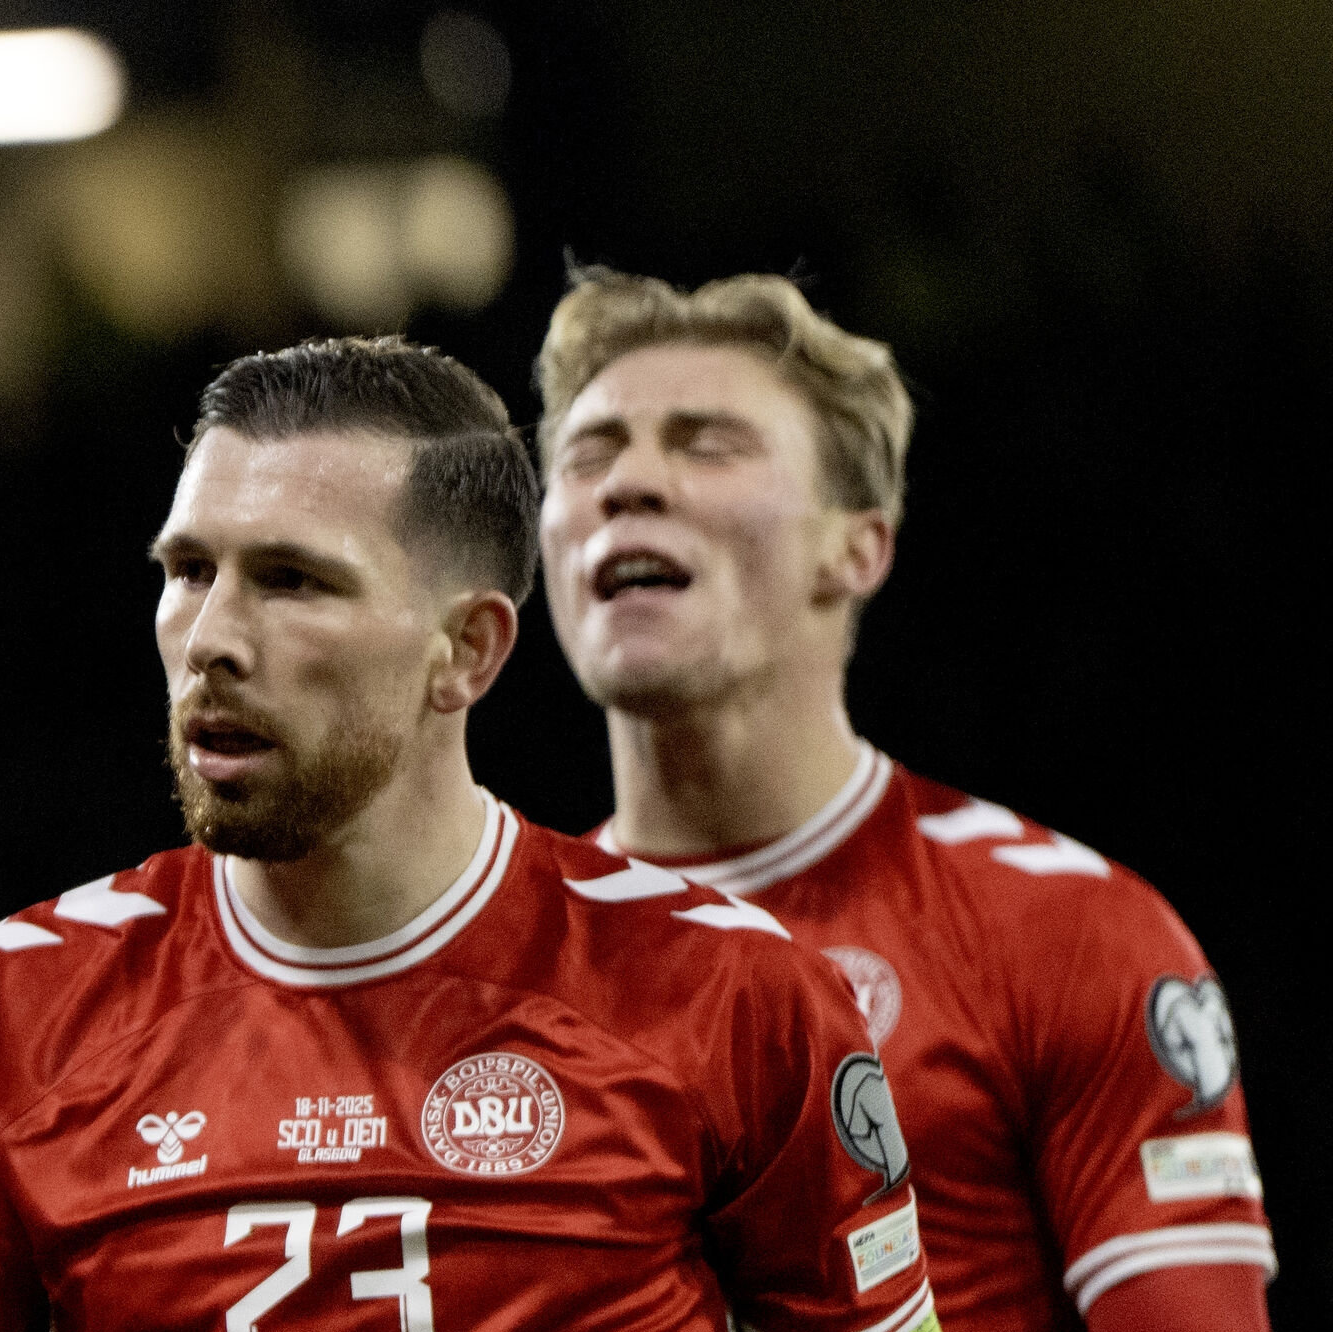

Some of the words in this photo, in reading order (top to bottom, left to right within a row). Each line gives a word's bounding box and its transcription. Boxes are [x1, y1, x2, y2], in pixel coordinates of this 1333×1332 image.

[295, 1094, 374, 1117] 18-11-2025
[451, 1096, 534, 1137] DBU
[277, 1118, 322, 1149] SCO
[343, 1116, 387, 1148] DEN
[426, 1093, 461, 1164] DANSK
[127, 1153, 209, 1189] hummel
[297, 1147, 362, 1164] GLASGOW
[467, 1158, 523, 1173] 1889
